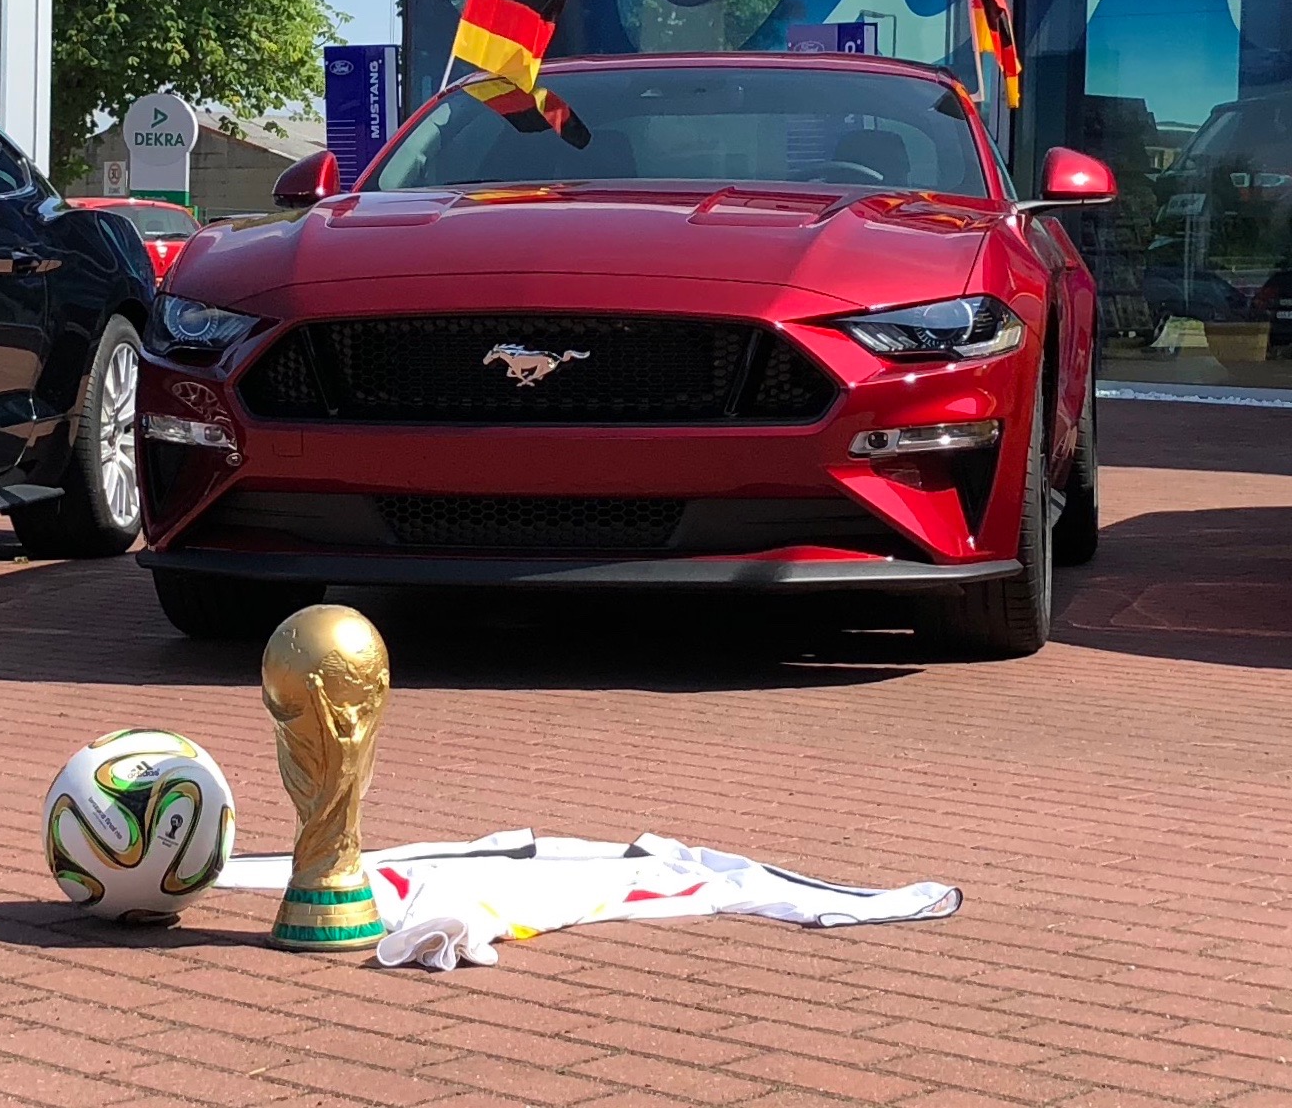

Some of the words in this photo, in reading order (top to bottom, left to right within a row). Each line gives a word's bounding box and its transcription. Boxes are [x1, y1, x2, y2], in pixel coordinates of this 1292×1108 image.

[369, 60, 381, 140] MUSTANG
[134, 132, 186, 147] DEKRA
[127, 768, 160, 779] adidas
